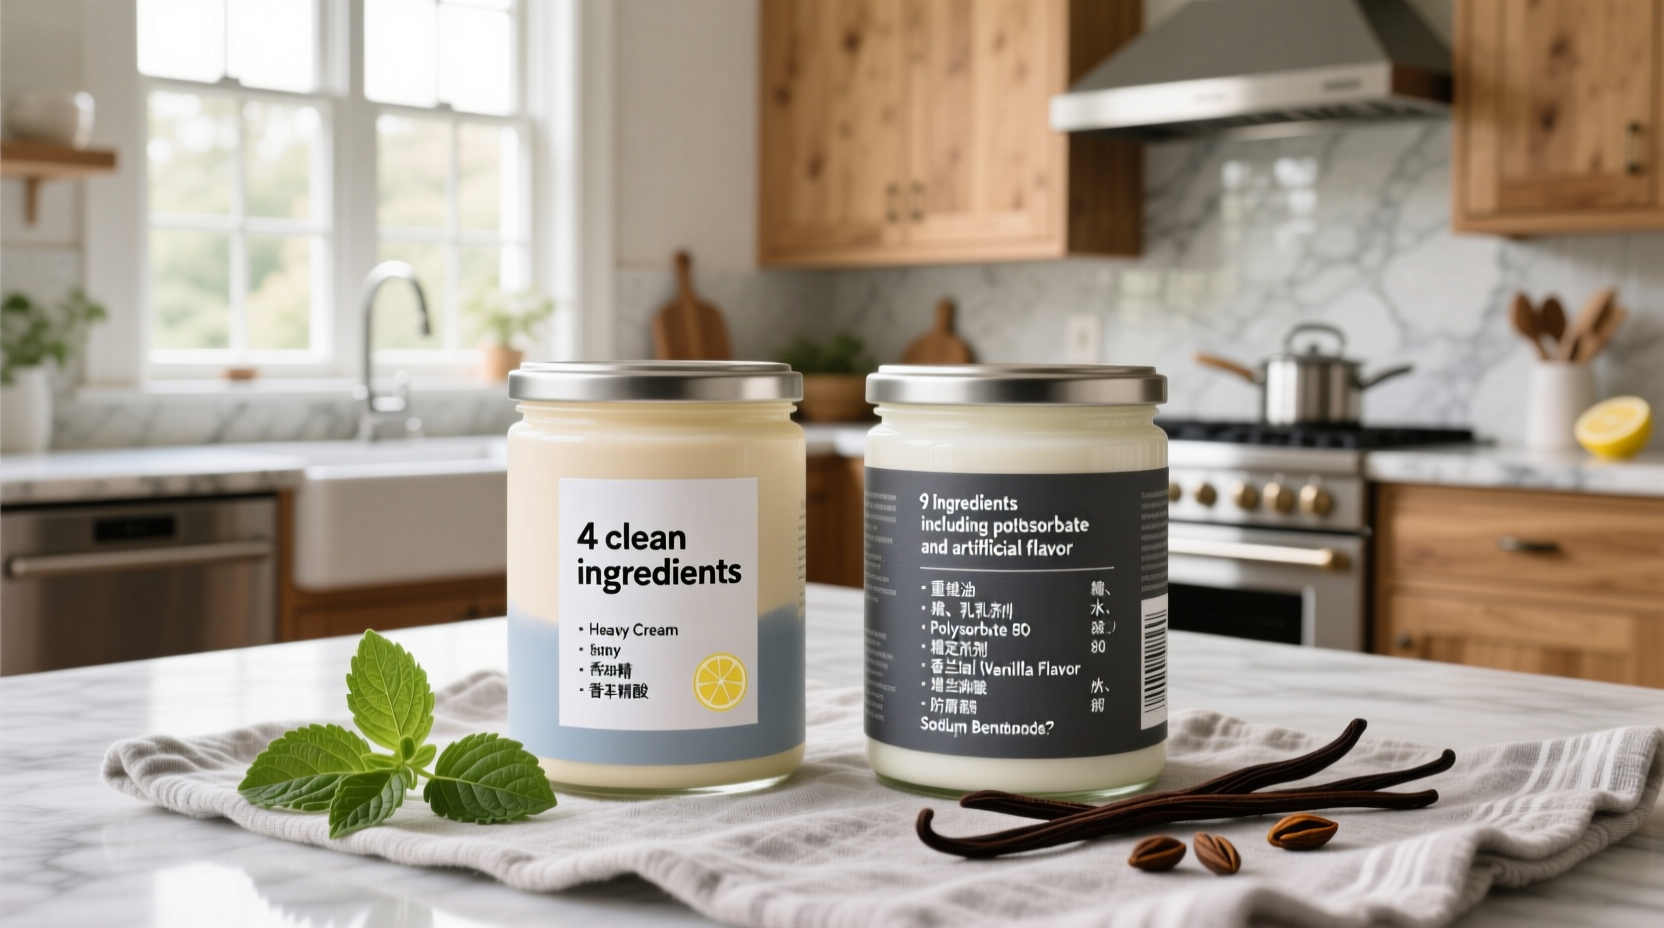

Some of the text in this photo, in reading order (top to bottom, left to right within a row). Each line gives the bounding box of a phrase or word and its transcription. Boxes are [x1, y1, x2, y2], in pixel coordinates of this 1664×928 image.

[919, 493, 930, 510] 9
[921, 515, 988, 536] including
[577, 522, 686, 550] 4 clean
[921, 538, 948, 555] and
[1027, 539, 1073, 556] flavor
[577, 557, 742, 595] ingredients
[589, 622, 678, 640] Heavy Cream
[1038, 661, 1081, 676] Flavor
